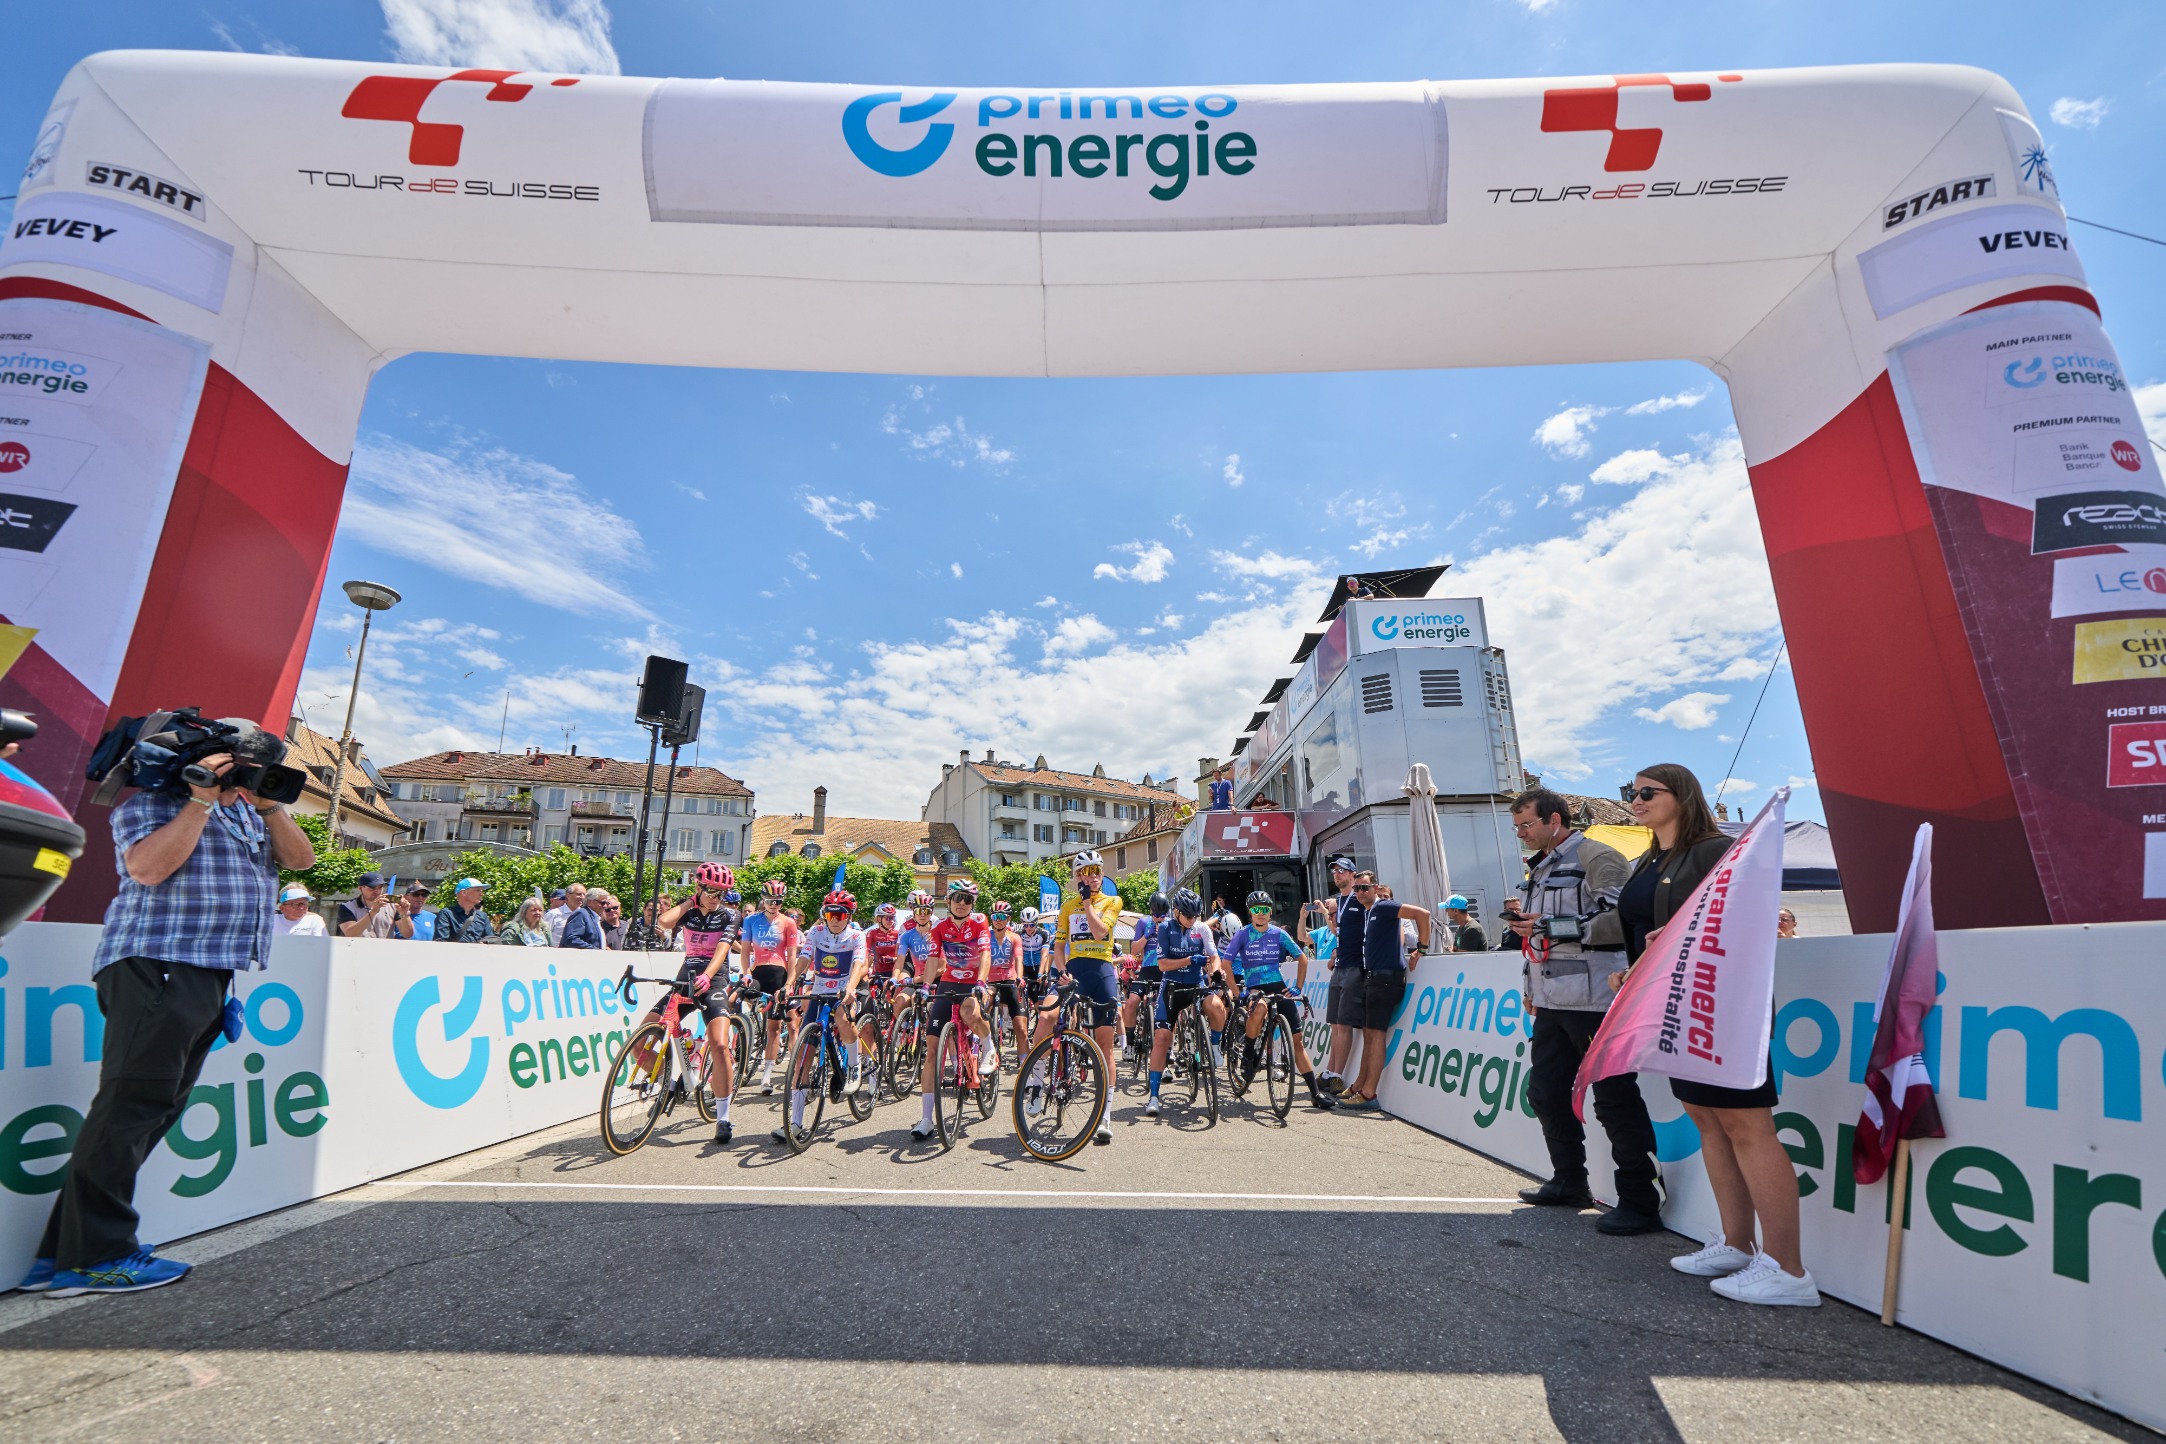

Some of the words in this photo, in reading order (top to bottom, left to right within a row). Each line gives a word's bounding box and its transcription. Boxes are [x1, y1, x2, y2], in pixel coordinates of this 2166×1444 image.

[978, 92, 1238, 127] primeo
[975, 120, 1257, 201] energie
[88, 166, 202, 212] START
[298, 170, 404, 191] TOUR
[408, 178, 458, 194] de
[464, 180, 600, 201] SUISSE
[1487, 186, 1592, 204] TOUR
[1592, 183, 1645, 200] de
[1647, 176, 1789, 198] SUISSE
[1885, 178, 1991, 229] START
[14, 218, 118, 243] VEVEY
[1979, 230, 2068, 253] VEVEY
[1985, 339, 2019, 351] MAIN
[2022, 333, 2072, 345] PARTNER
[2051, 352, 2119, 374] primeo
[0, 371, 89, 393] nergie
[2056, 371, 2126, 392] energie
[2013, 416, 2073, 432] PREMIUM
[2076, 415, 2121, 425] PARTNER
[2059, 442, 2089, 452] Bank
[2062, 451, 2106, 462] Banque
[2111, 448, 2141, 466] WIR
[1403, 612, 1465, 628] primeo
[1404, 625, 1470, 642] energie
[2107, 706, 2147, 718] HOST
[1699, 868, 1733, 957] grand
[690, 933, 709, 945] EF
[758, 930, 778, 938] UAE
[501, 963, 639, 1037] primeo
[1658, 936, 1696, 1056] hospitalité
[1688, 961, 1722, 1065] merci
[1771, 970, 2166, 1122] prim
